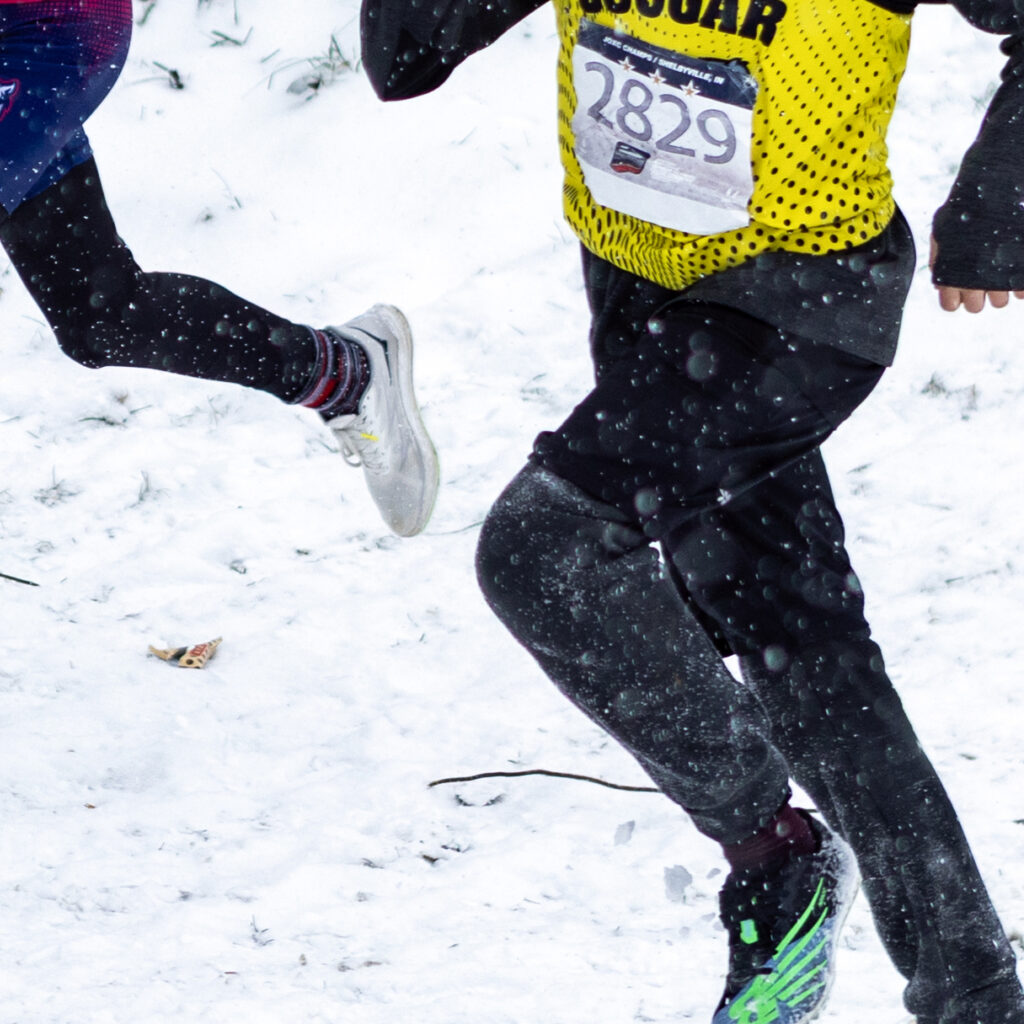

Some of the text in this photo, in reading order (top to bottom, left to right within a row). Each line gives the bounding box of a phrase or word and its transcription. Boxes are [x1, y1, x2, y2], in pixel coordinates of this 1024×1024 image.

[622, 44, 653, 61] CHAMPS
[658, 58, 713, 82] SHELBYVILLE,
[584, 61, 736, 164] 2829
